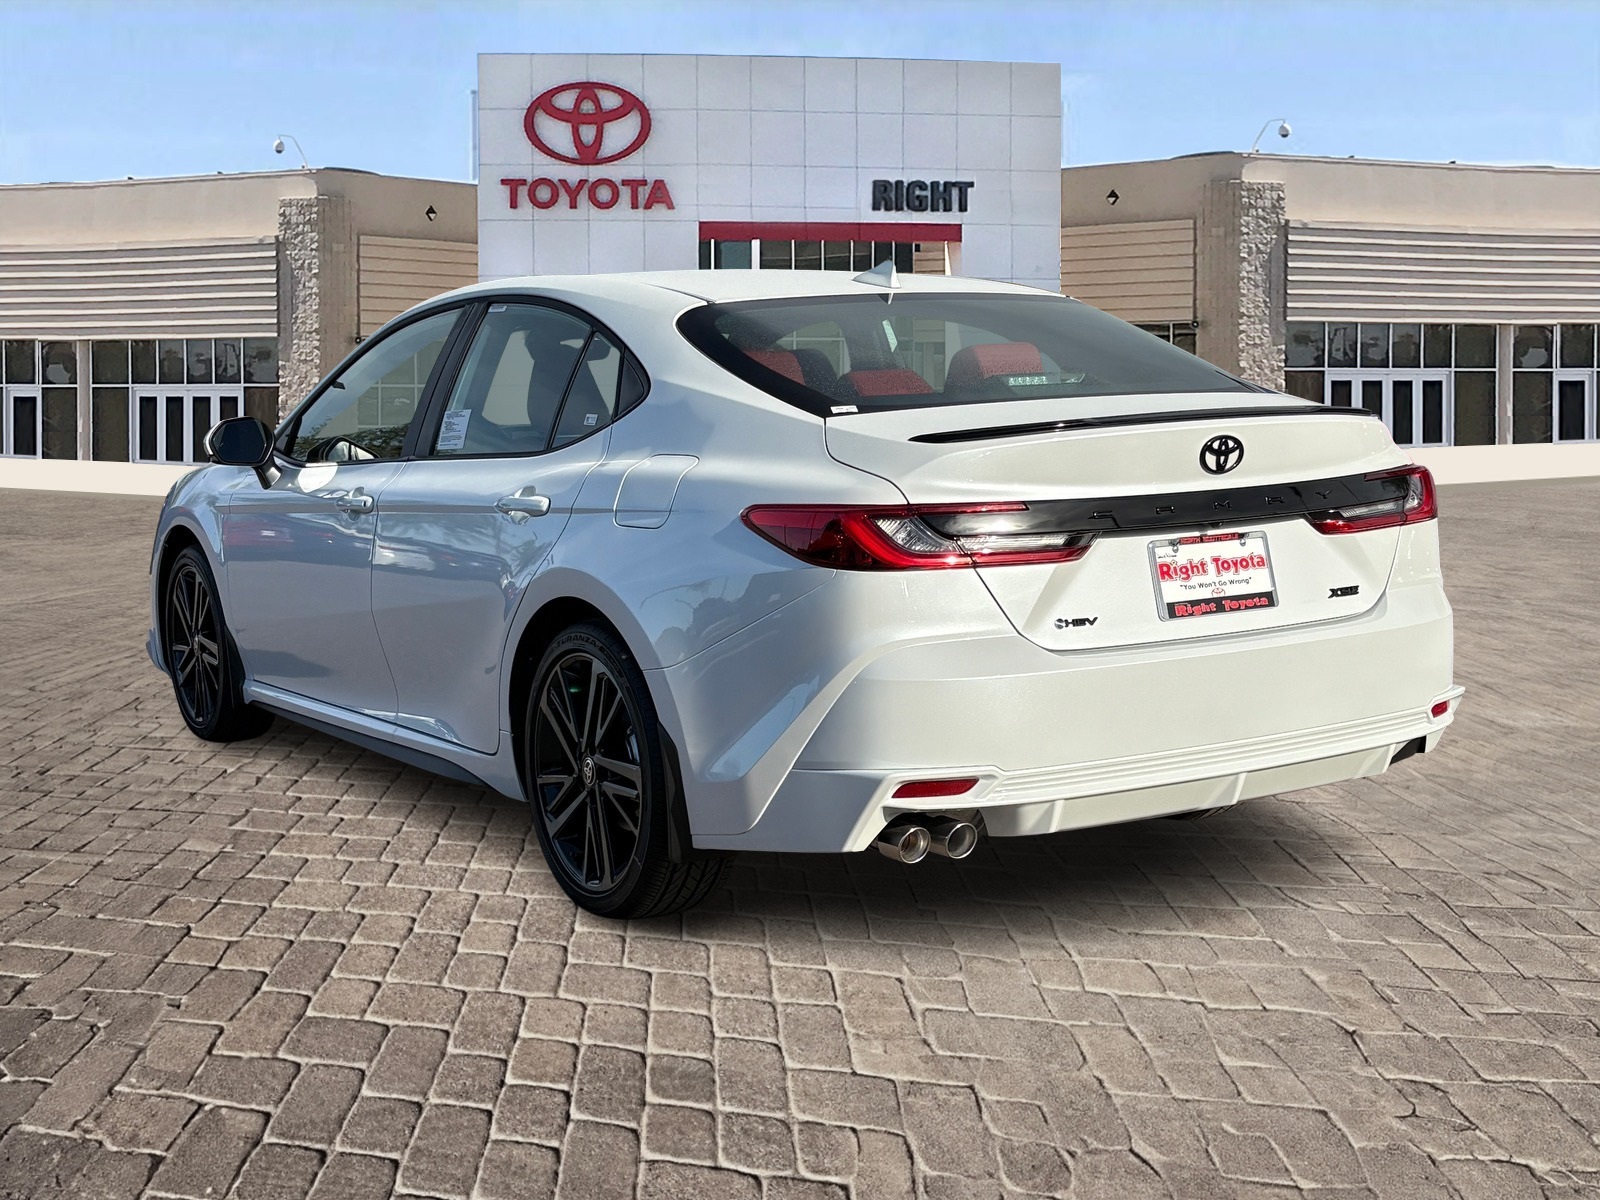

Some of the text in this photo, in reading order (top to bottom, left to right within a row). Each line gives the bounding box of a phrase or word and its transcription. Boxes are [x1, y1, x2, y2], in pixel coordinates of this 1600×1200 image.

[500, 178, 675, 210] TOYOTA
[871, 180, 975, 213] RIGHT
[1158, 553, 1267, 582] Right Toyota
[1198, 581, 1217, 589] Won't
[1328, 585, 1359, 598] XSE
[1175, 597, 1268, 616] Right Toyota
[556, 635, 597, 648] TURANZA
